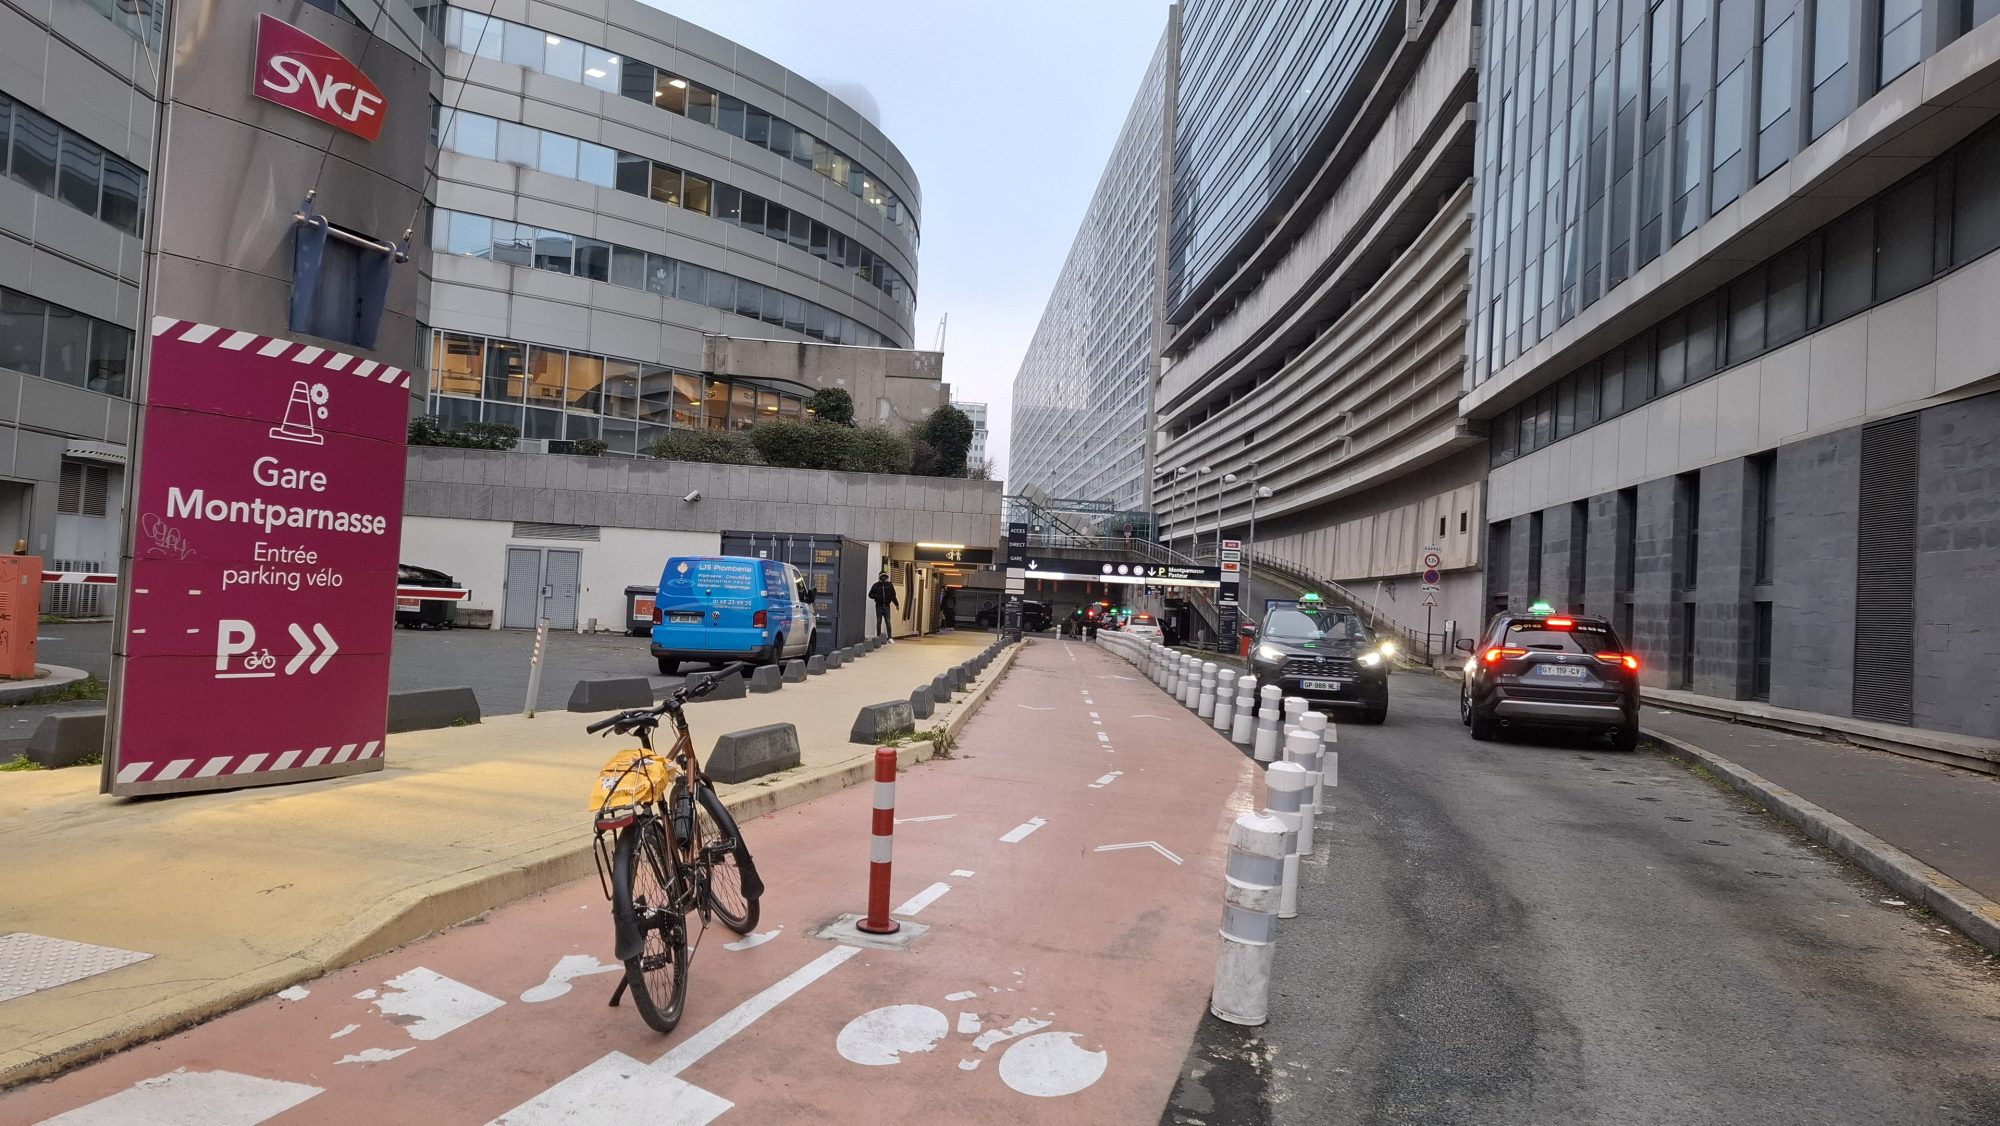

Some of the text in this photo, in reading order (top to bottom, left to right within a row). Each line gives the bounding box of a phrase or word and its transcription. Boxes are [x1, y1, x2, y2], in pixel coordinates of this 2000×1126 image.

[263, 55, 382, 122] SNCF
[253, 456, 327, 492] Gare
[166, 487, 386, 535] Montparnasse
[253, 541, 318, 564] Entrée
[222, 565, 343, 591] parking vélo
[713, 564, 752, 573] Plomberie
[1159, 566, 1205, 576] P Montparnasse
[216, 619, 256, 671] P
